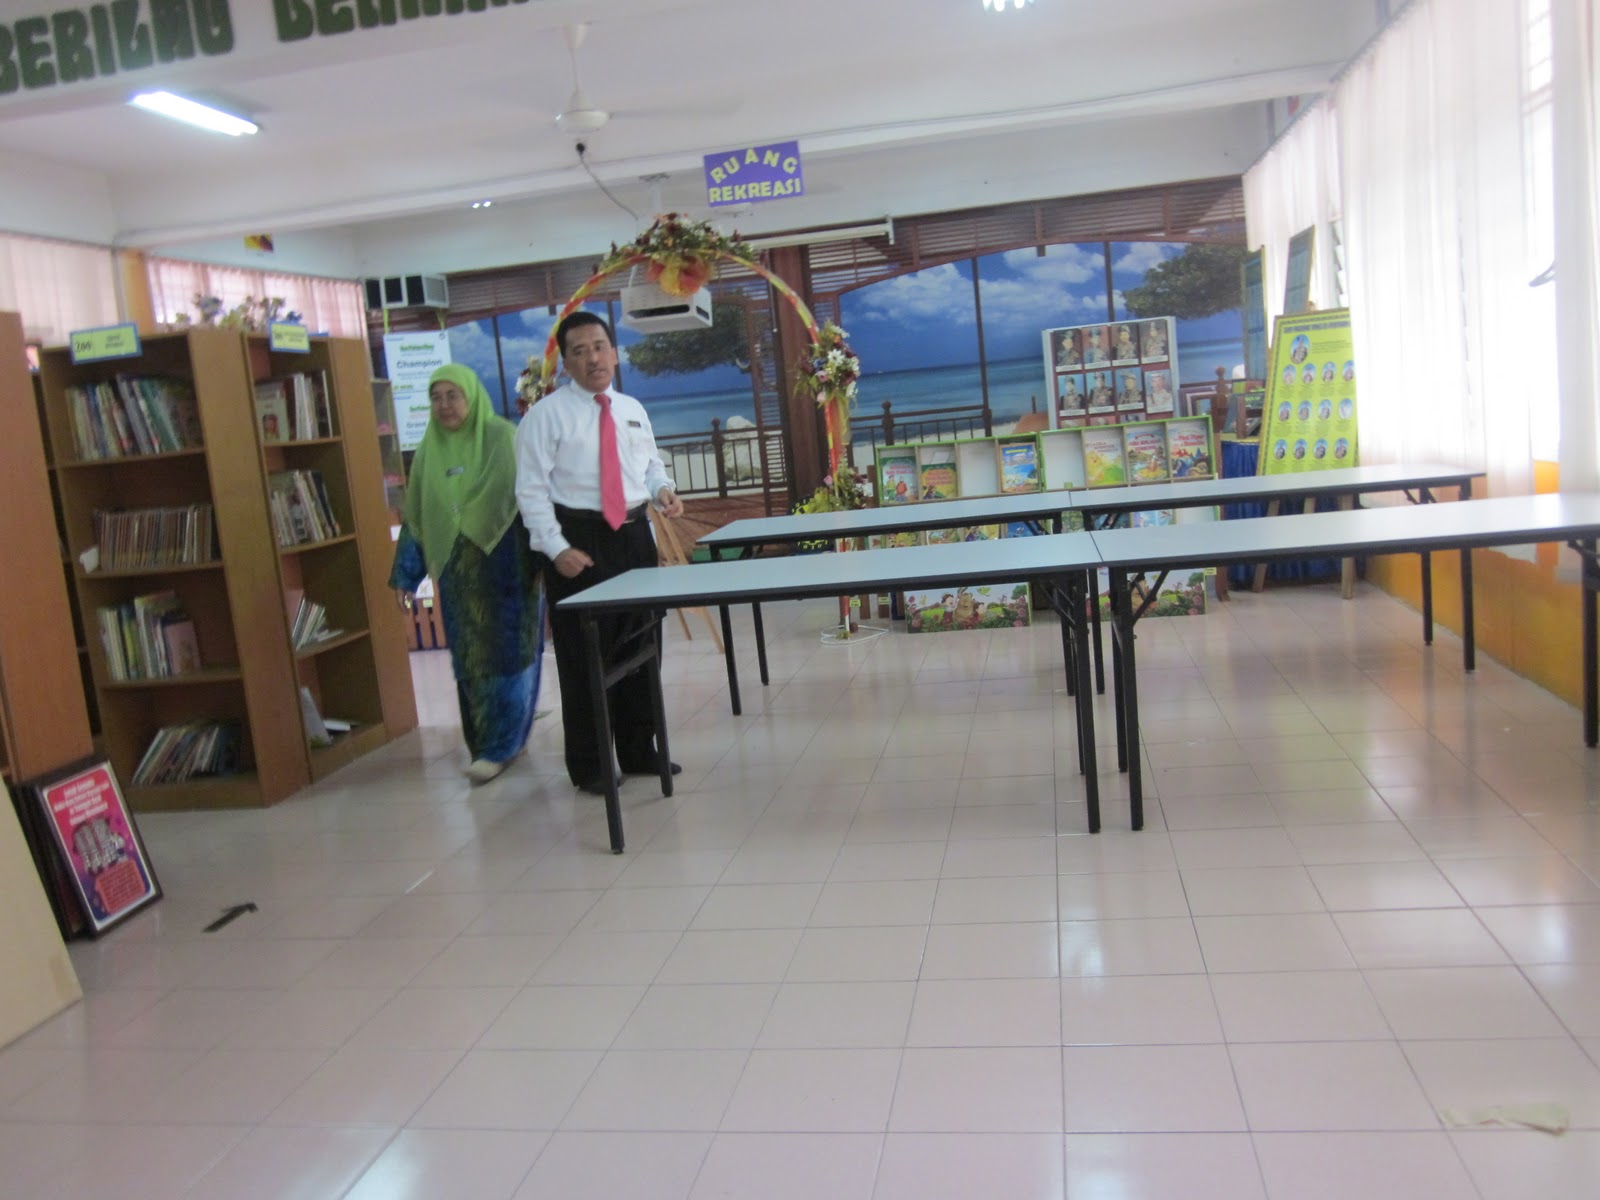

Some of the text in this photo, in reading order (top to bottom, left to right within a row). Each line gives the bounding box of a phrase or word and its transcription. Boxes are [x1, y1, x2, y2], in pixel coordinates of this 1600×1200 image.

[709, 148, 798, 184] RUANG
[709, 178, 801, 203] REKREASI
[396, 359, 443, 369] Champion
